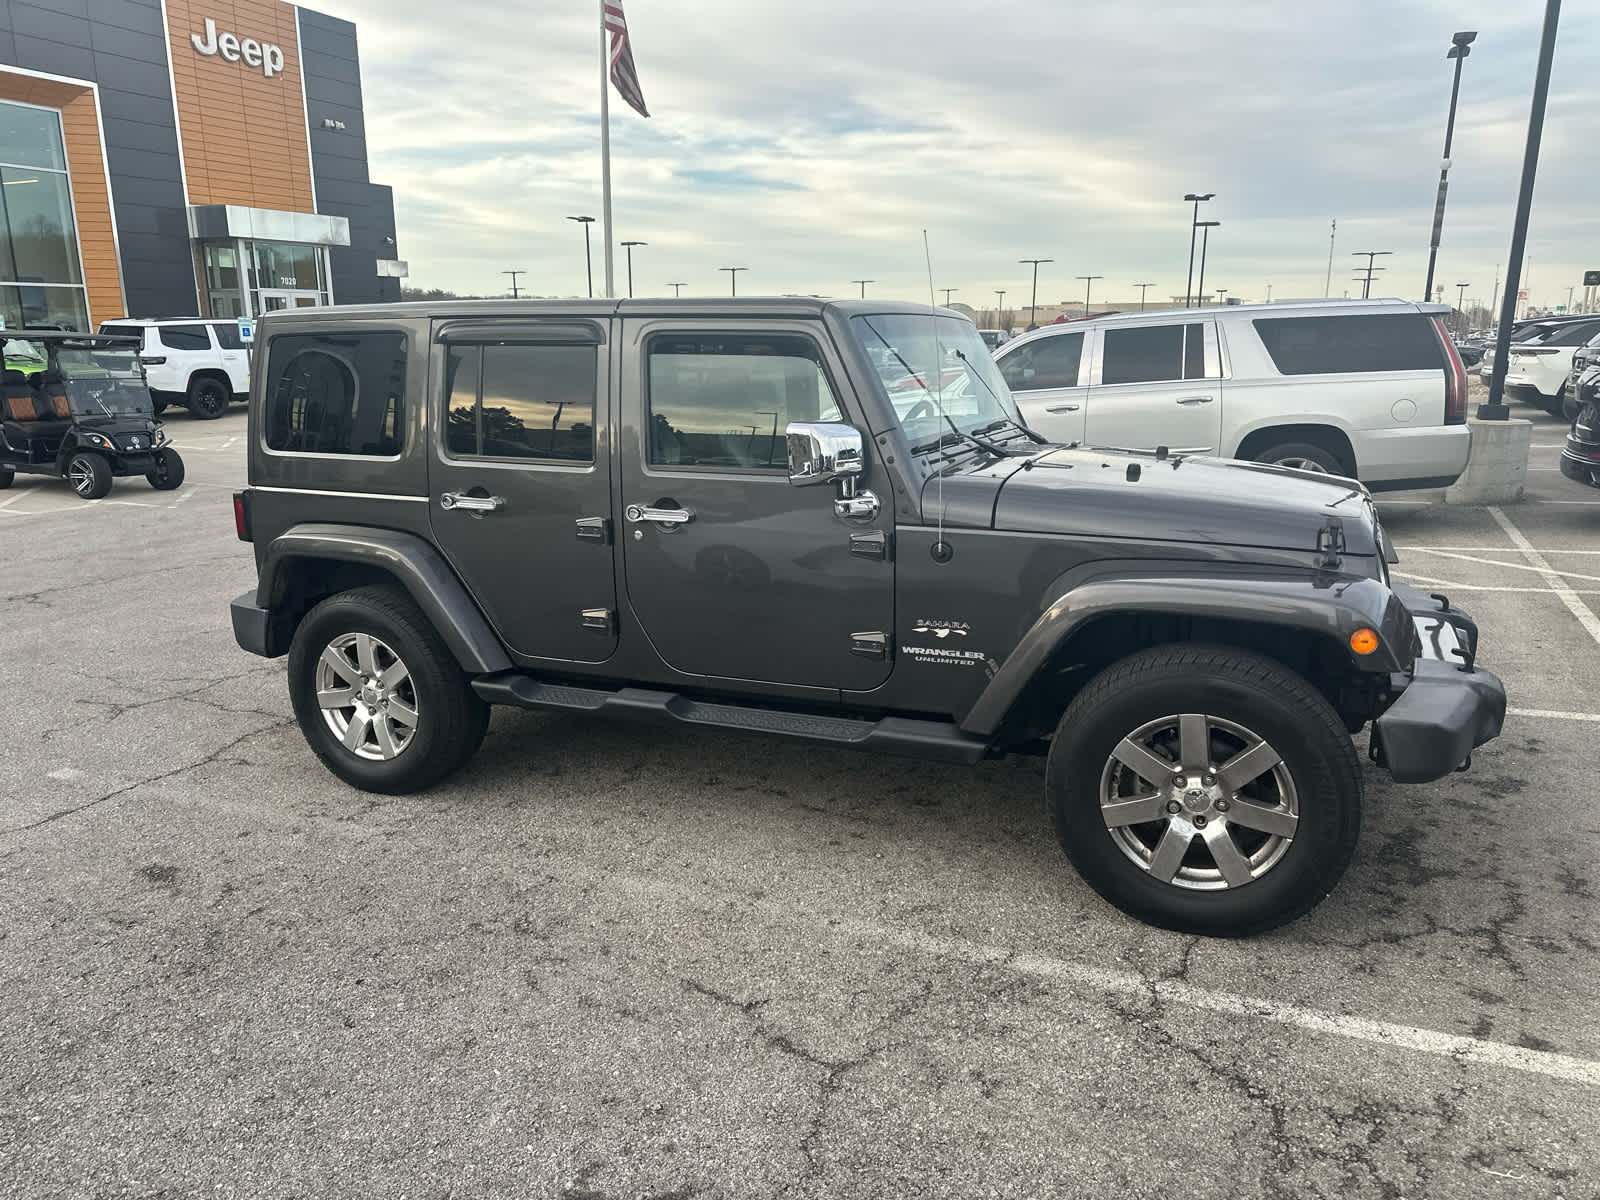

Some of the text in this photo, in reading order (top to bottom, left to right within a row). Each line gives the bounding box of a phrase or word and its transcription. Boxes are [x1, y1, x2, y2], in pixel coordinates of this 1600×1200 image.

[191, 17, 284, 77] Jeep
[916, 619, 970, 629] SAHARA
[902, 646, 984, 660] WRANGLER
[915, 656, 975, 666] UNLIMITED
